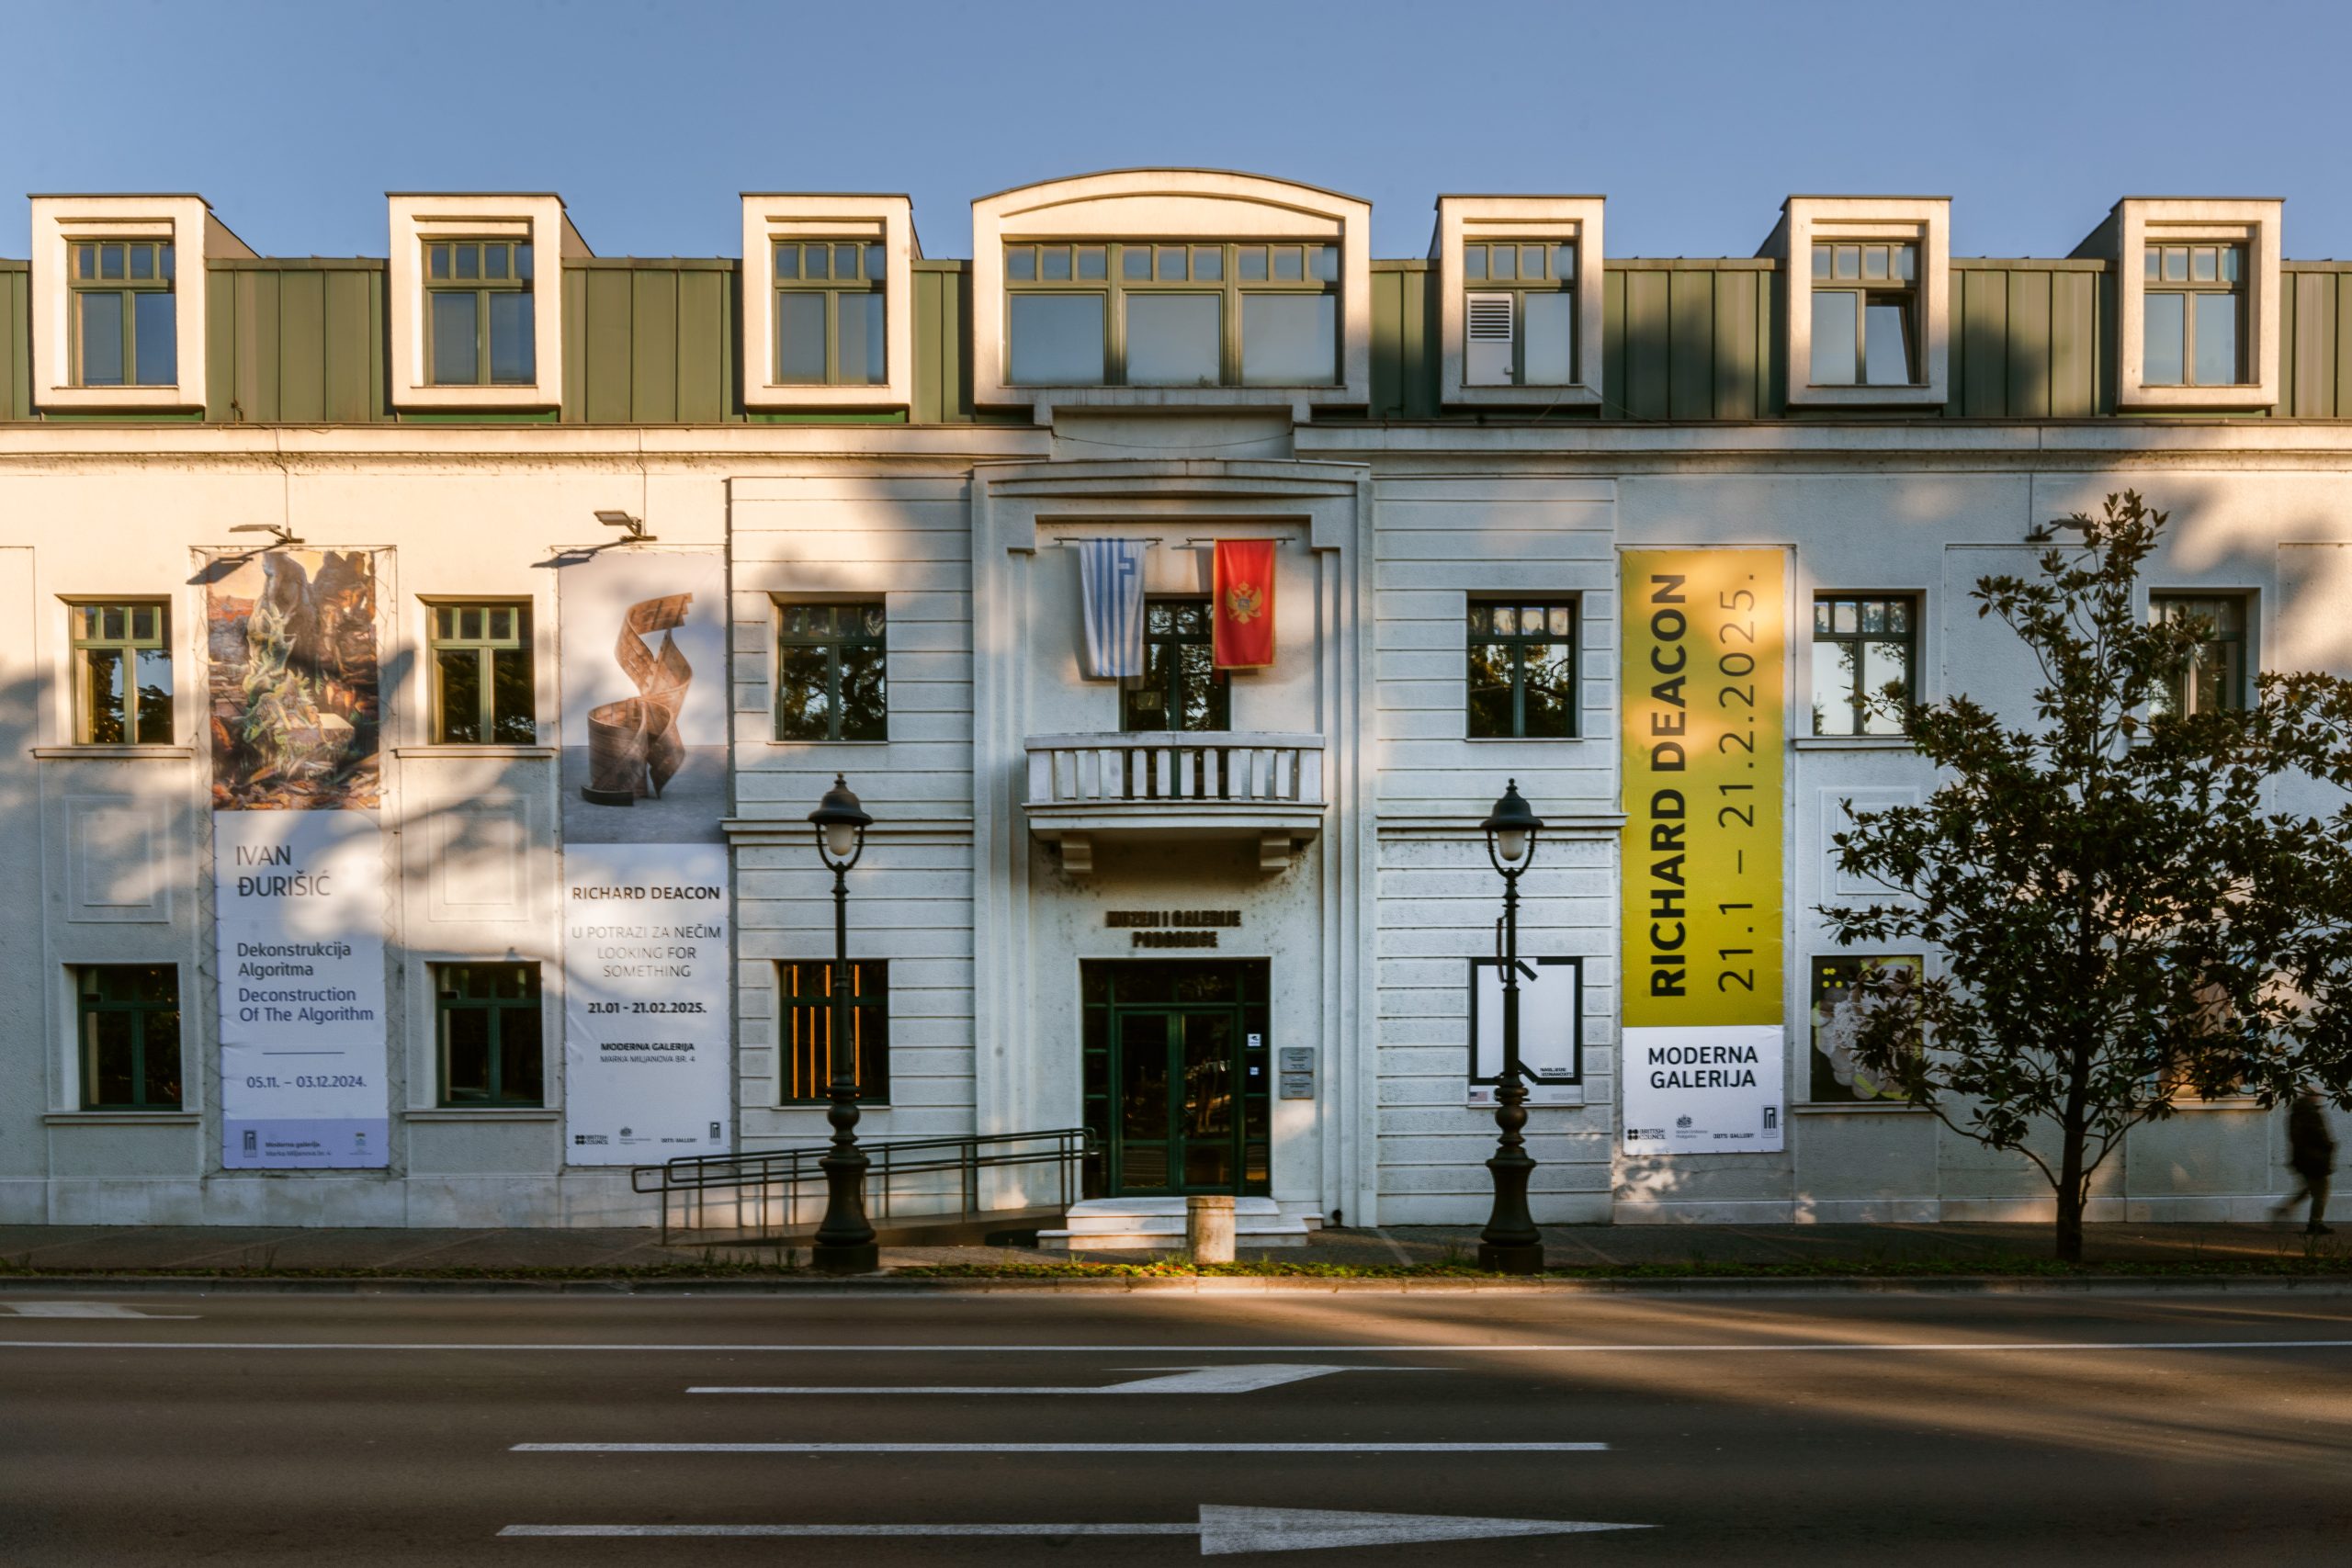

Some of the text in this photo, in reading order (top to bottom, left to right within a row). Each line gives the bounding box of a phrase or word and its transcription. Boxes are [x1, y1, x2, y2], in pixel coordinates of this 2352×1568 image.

[1718, 574, 1754, 829] 21.2.2025.
[1650, 574, 1686, 998] RICHARD DEACON
[236, 845, 291, 865] IVAN
[237, 869, 331, 897] ĐURIŠIĆ
[571, 886, 720, 900] RICHARD DEACON
[571, 923, 721, 939] U POTRAZI ZA NEČIM
[1131, 931, 1218, 948] PODGORICE
[237, 942, 352, 959] Dekonstrukcija
[597, 946, 697, 959] LOOKING FOR
[1718, 901, 1754, 993] 21.1
[238, 962, 314, 980] Algoritma
[603, 964, 692, 978] SOMETHING
[239, 987, 357, 1002] Deconstruction
[240, 1006, 374, 1025] Of The Algorithm
[588, 1002, 620, 1014] 21.01
[631, 1002, 707, 1014] 21.02.2025.
[600, 1043, 695, 1053] MODERNA GALERIJA
[1647, 1045, 1758, 1066] MODERNA
[246, 1077, 281, 1089] 05.11.
[296, 1076, 368, 1089] 03.12.2024.
[1650, 1069, 1757, 1089] GALERIJA
